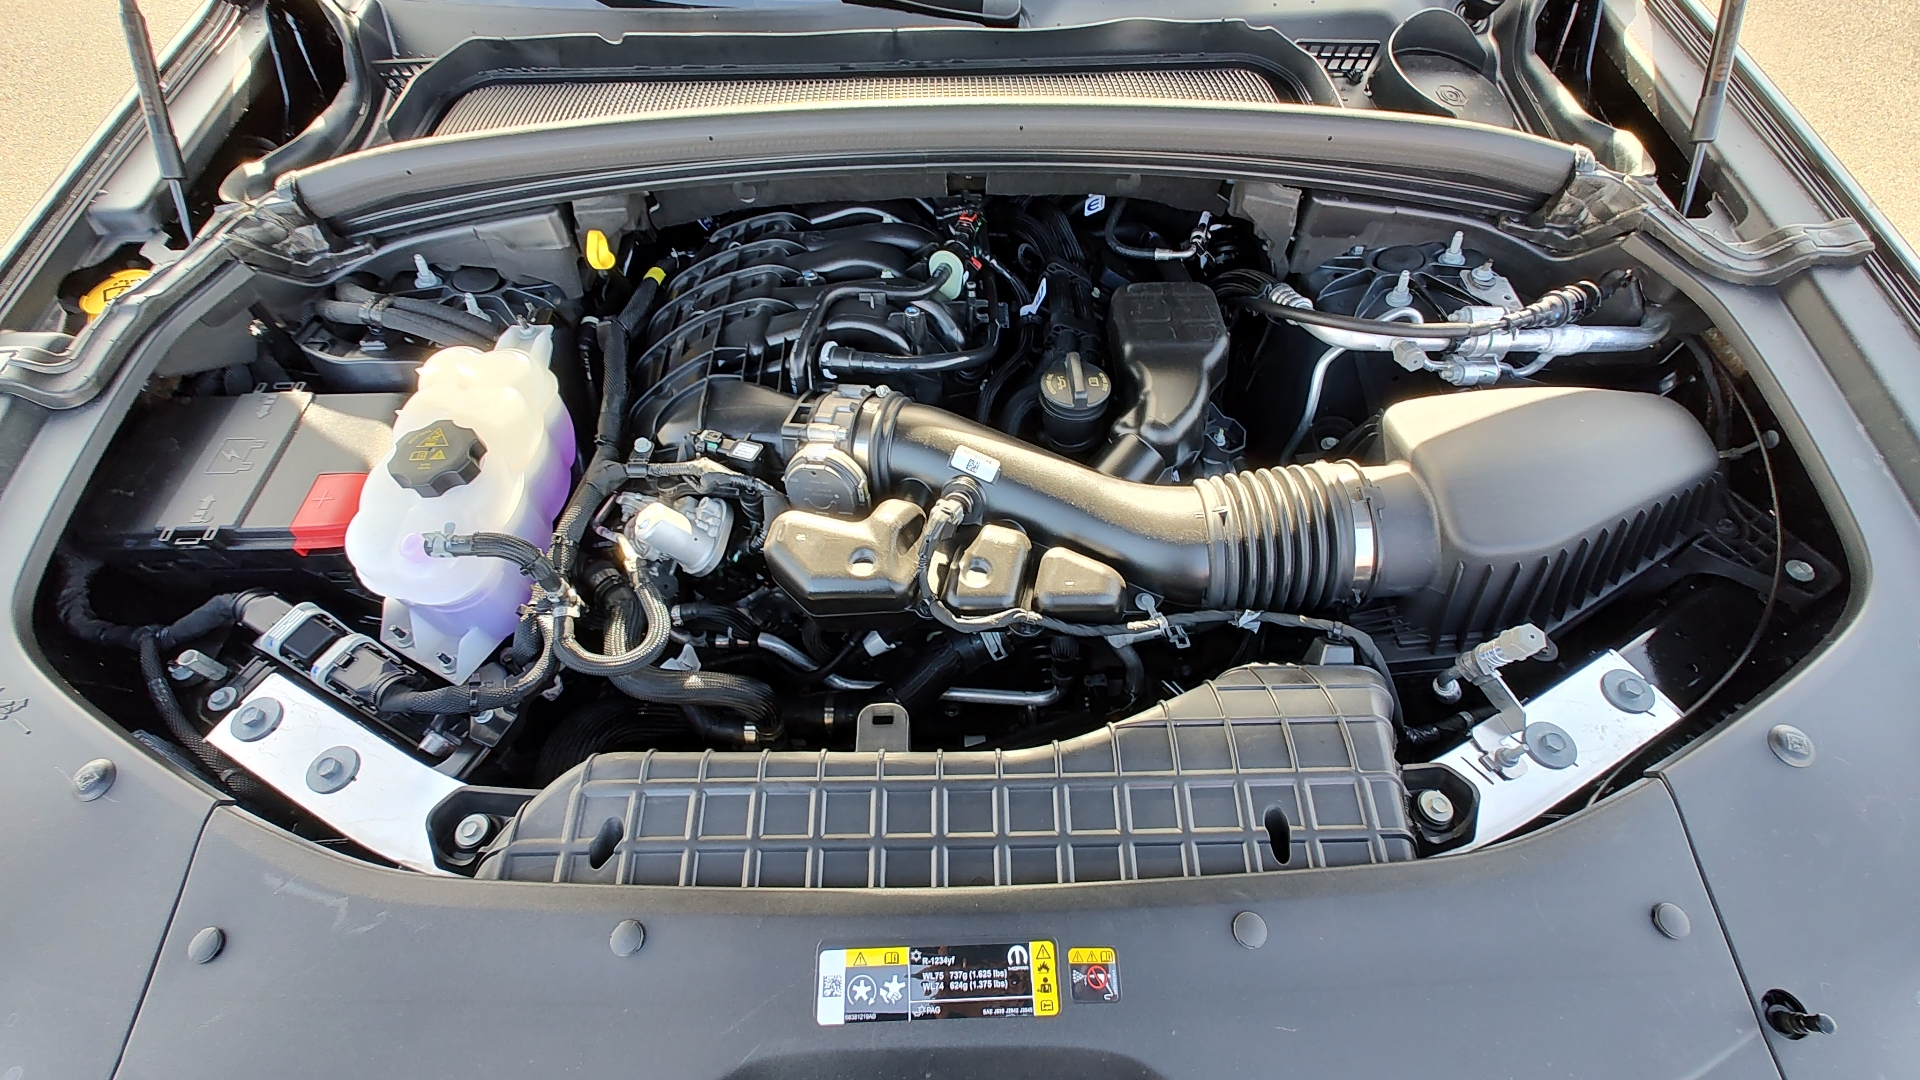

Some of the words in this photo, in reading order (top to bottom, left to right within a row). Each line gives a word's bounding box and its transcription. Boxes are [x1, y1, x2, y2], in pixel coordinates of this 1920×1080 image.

[922, 956, 955, 967] R-1234yf
[922, 972, 944, 980] WL75
[950, 971, 967, 980] 737g
[969, 970, 992, 980] (1.625
[993, 969, 1007, 979] lbs)
[922, 982, 944, 991] WL74
[950, 981, 968, 991] 624g
[970, 980, 992, 991] (1.375
[993, 980, 1008, 989] lbs)
[926, 1006, 940, 1014] PAG
